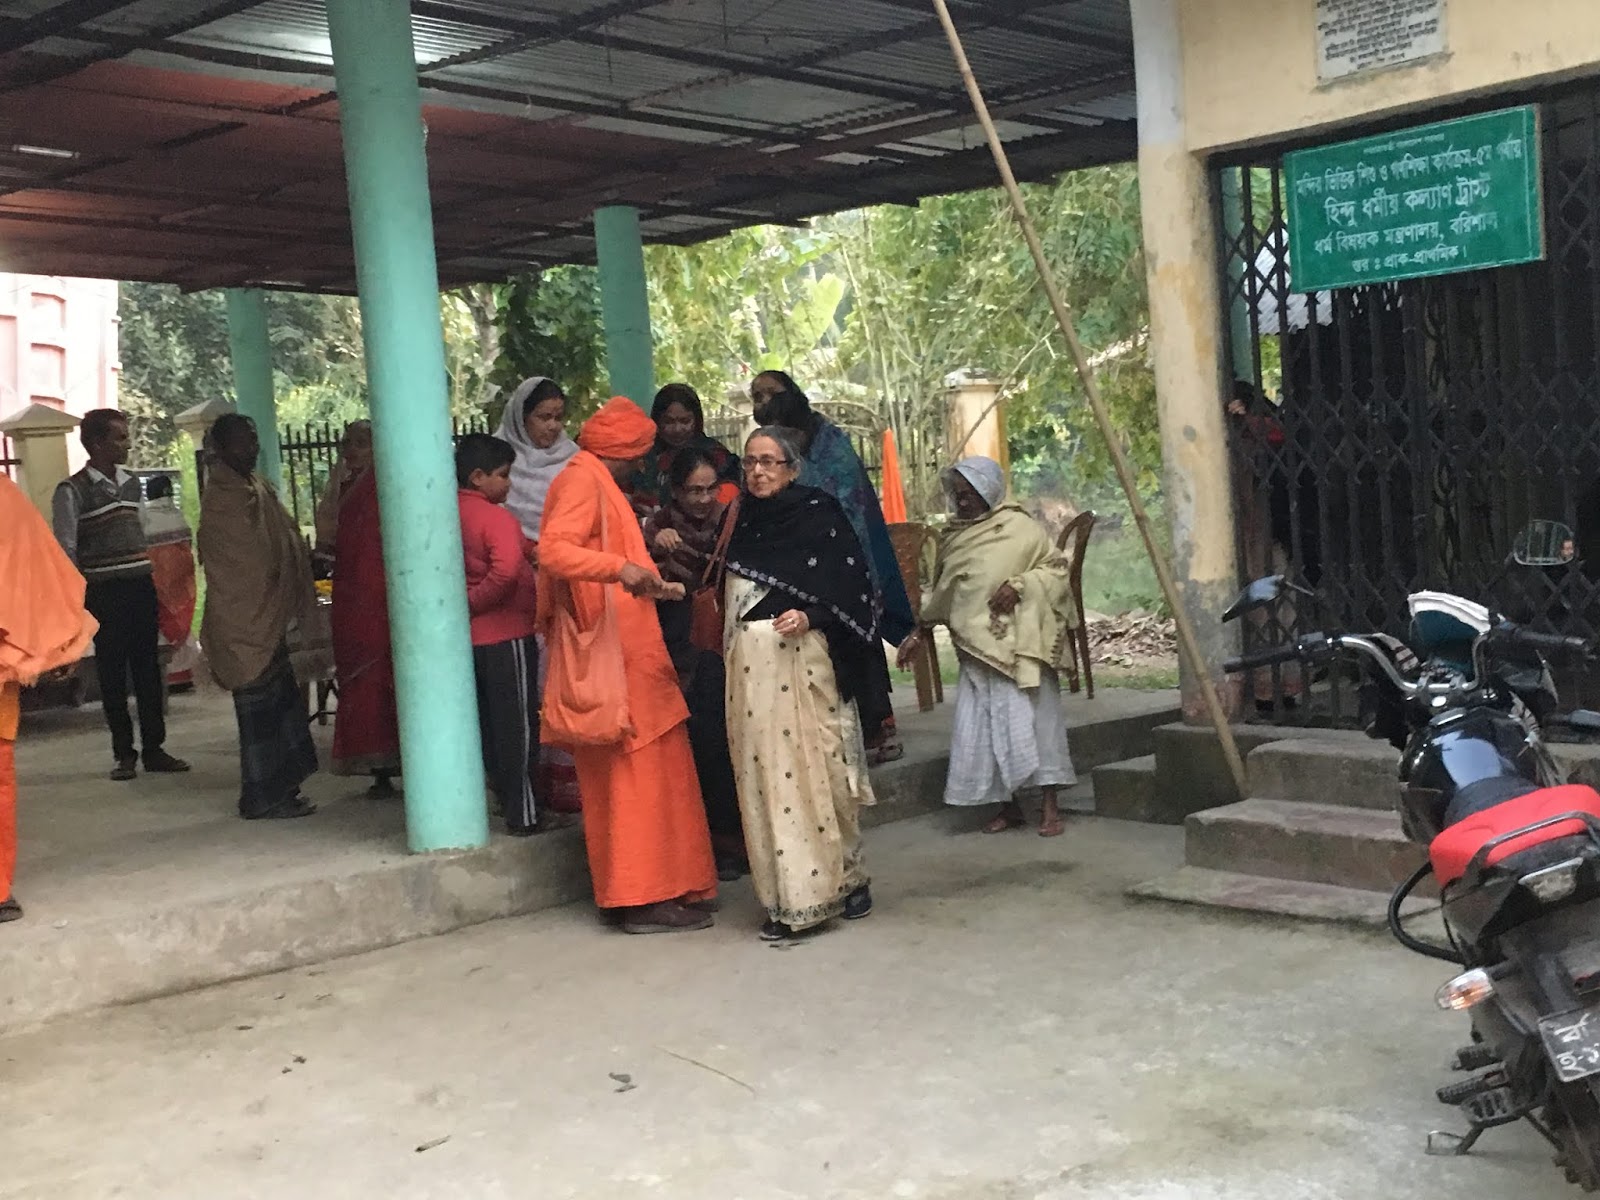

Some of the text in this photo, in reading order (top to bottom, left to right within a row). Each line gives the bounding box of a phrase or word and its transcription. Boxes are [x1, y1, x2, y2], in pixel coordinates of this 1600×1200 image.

[1323, 196, 1358, 227] হিন্দু
[1403, 182, 1453, 212] কল্যাণ
[1314, 230, 1333, 255] ধর্ম
